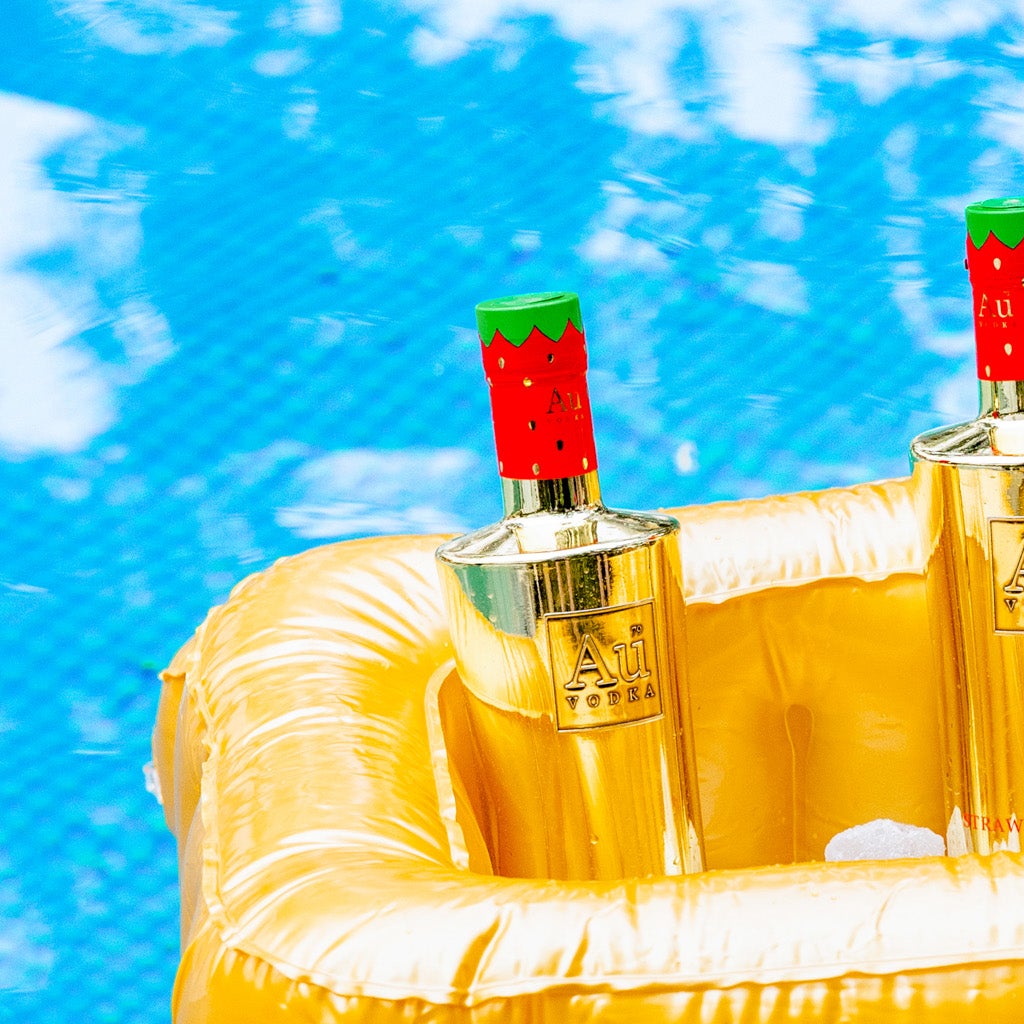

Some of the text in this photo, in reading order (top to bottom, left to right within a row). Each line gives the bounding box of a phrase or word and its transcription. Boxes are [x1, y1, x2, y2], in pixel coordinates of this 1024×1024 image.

[977, 292, 1014, 319] Au
[546, 387, 583, 415] Au
[629, 623, 644, 638] 79
[563, 633, 652, 692] Au
[565, 682, 656, 710] VODKA
